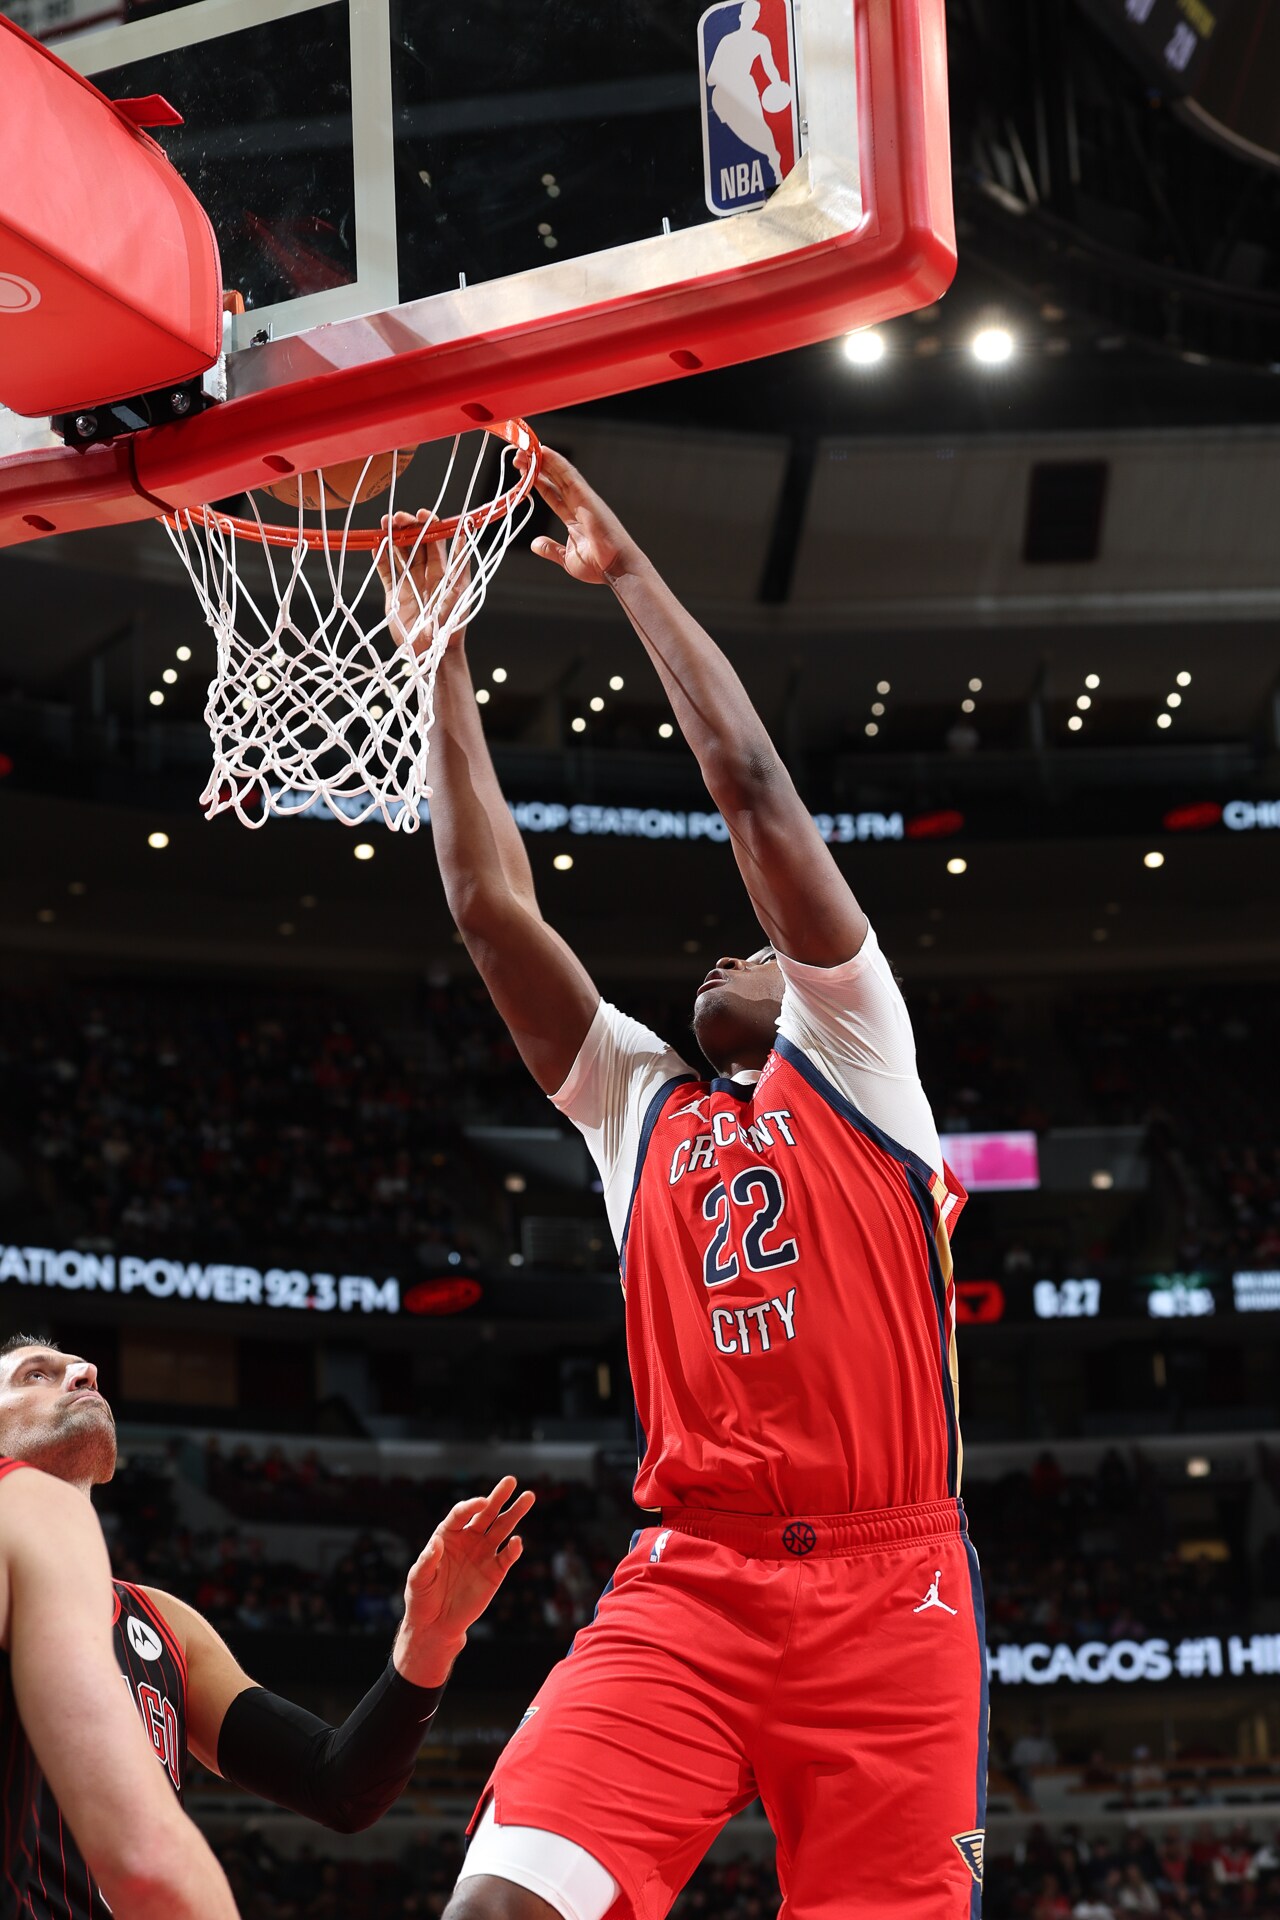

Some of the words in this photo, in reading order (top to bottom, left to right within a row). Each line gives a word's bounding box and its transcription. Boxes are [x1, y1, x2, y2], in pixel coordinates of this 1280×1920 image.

[720, 159, 765, 202] NBA
[569, 803, 688, 840] STATION
[855, 811, 905, 842] FM
[702, 1166, 800, 1288] 22
[0, 1243, 115, 1292] ATION
[119, 1254, 264, 1305] POWER
[264, 1268, 338, 1312] 92.3
[338, 1276, 400, 1314] FM
[711, 1287, 798, 1355] CITY
[986, 1637, 1173, 1685] HICAGOS
[1174, 1635, 1222, 1678] #1
[1228, 1632, 1280, 1677] HI
